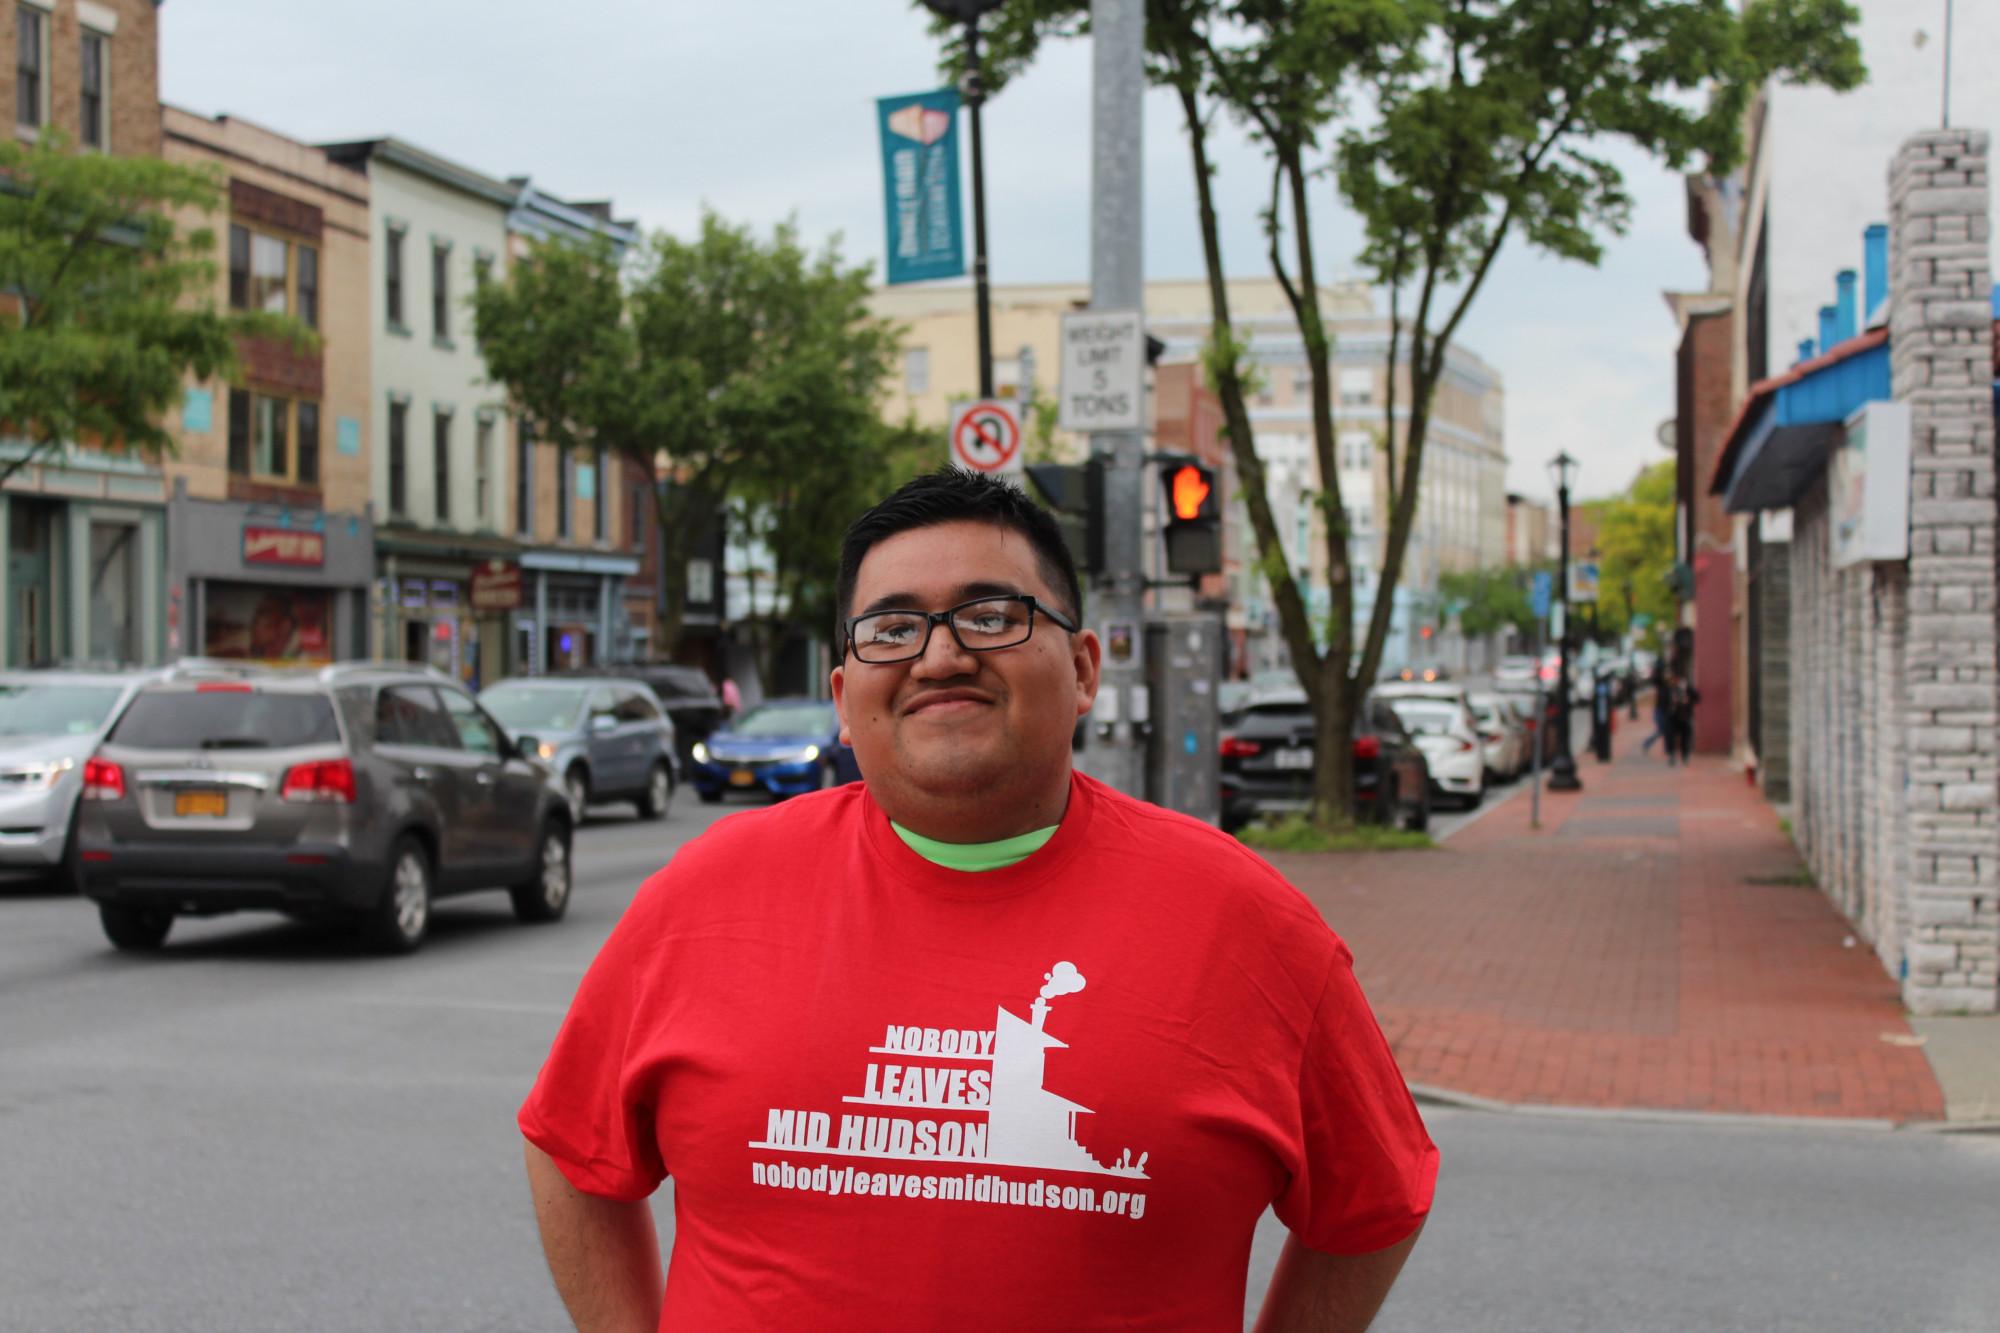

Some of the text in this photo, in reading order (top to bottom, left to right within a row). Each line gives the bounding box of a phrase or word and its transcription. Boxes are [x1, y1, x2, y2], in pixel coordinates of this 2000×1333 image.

[1078, 346, 1121, 366] LIMIT
[1094, 369, 1107, 390] 5
[1072, 393, 1129, 417] TONS
[885, 1025, 996, 1056] NOBODY
[864, 1063, 991, 1106] LEAVES
[767, 1108, 988, 1159] MID HUDSON
[752, 1160, 1147, 1220] nobodyleavesmidhudson.org
